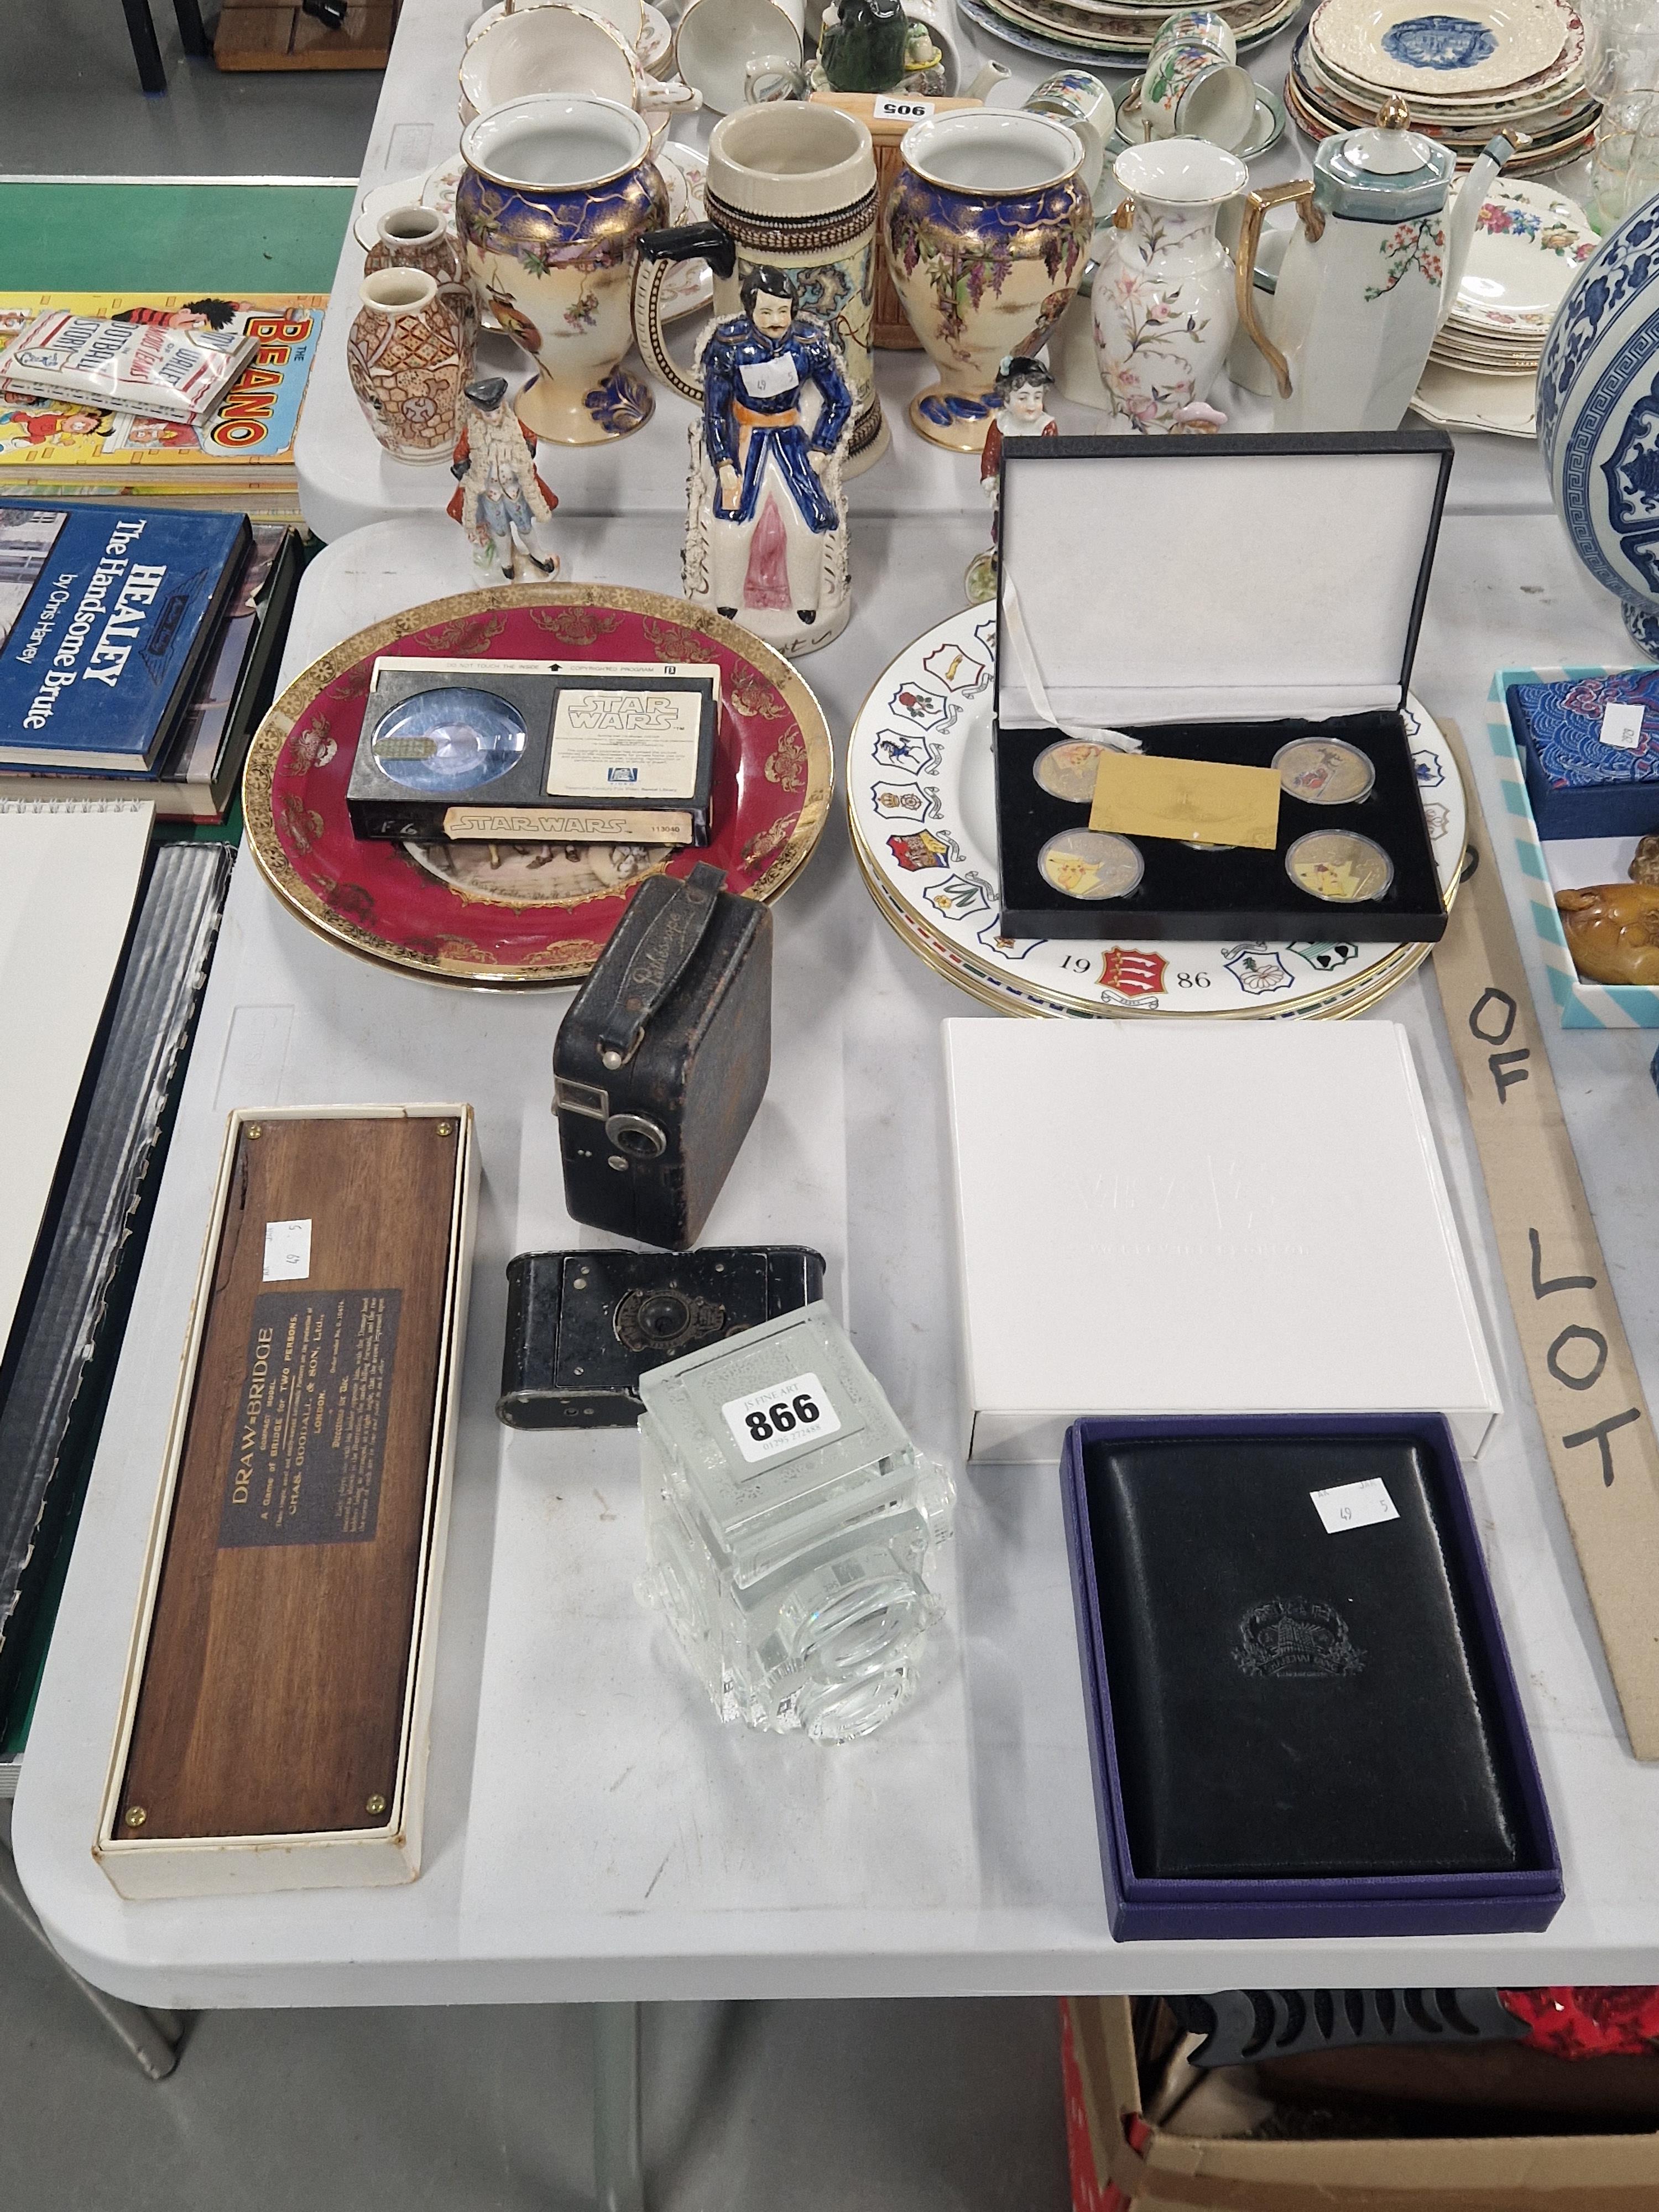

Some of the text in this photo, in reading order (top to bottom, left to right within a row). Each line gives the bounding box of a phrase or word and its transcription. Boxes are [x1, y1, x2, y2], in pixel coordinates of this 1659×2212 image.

[884, 104, 926, 116] 905
[77, 322, 139, 372] OOTBALL
[164, 343, 175, 353] OF
[294, 346, 307, 361] THE
[130, 348, 164, 379] TEAMS
[158, 348, 201, 387] WALLET
[210, 316, 314, 448] BEANO
[15, 573, 79, 664] by Chris Harvey
[23, 519, 147, 729] The Handsome Brute
[82, 564, 167, 687] HEALEY
[569, 696, 679, 714] STAR
[569, 712, 679, 730] WARS
[381, 821, 395, 833] F
[450, 815, 540, 833] STAR
[538, 817, 627, 834] WARS
[1059, 954, 1211, 989] 19 86
[1469, 987, 1641, 1487] OF LOT
[286, 1254, 300, 1264] 49
[307, 1346, 321, 1377] SON,
[305, 1382, 315, 1392] &
[755, 1391, 778, 1405] FINE
[781, 1383, 800, 1396] ART
[260, 1313, 299, 1520] A Game of BRIDGE for TWO PERSONS.
[312, 1389, 326, 1434] LONDON.
[745, 1394, 820, 1442] 866
[259, 1414, 271, 1451] COMPACT
[294, 1397, 312, 1467] GOODALL
[763, 1424, 822, 1451] 01295 272488
[1340, 1500, 1388, 1521] 49 5
